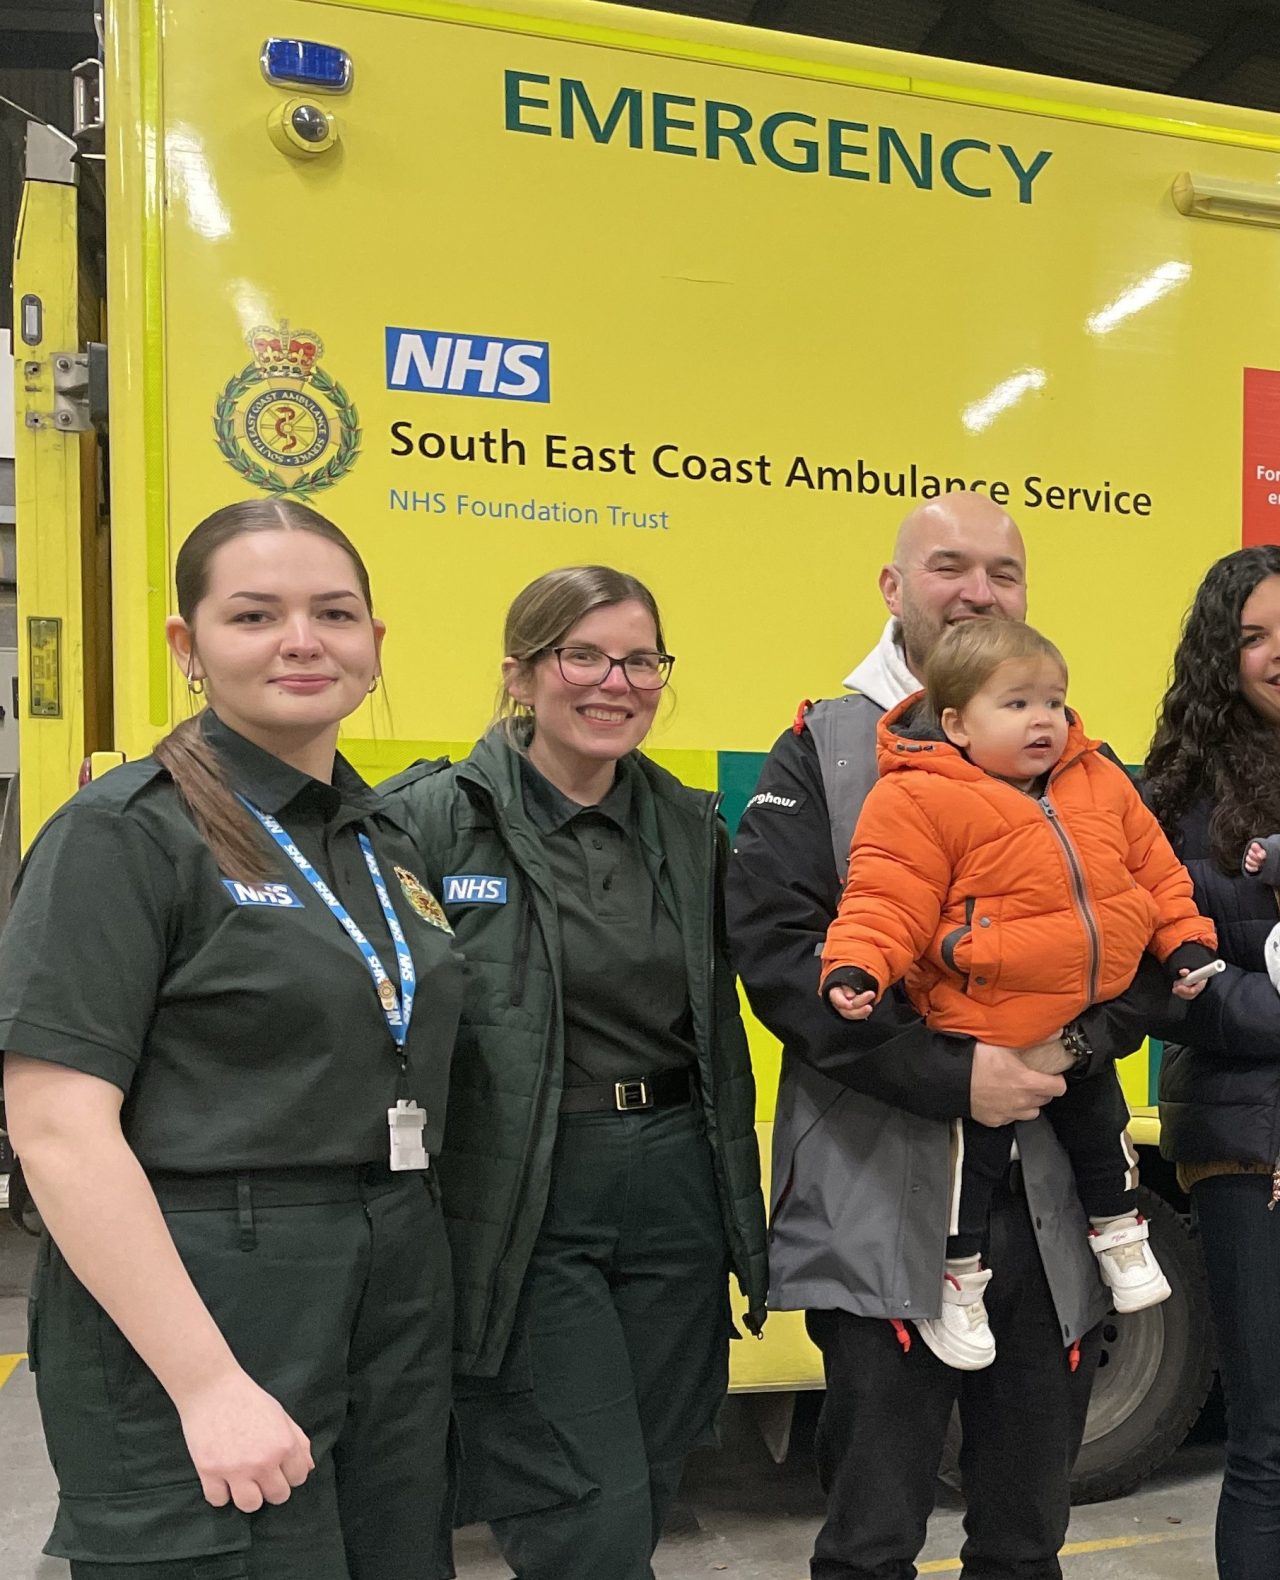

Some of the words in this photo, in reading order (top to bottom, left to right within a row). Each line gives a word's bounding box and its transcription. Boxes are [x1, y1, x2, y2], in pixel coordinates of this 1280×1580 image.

[504, 69, 1053, 204] EMERGENCY
[391, 333, 544, 397] NHS
[390, 421, 526, 466] South
[545, 434, 637, 475] East
[652, 444, 772, 486] Coast
[1024, 476, 1152, 516] Service
[390, 489, 446, 514] NHS
[457, 495, 598, 525] Foundation
[606, 505, 669, 530] Trust
[747, 792, 797, 807] ghaus
[449, 879, 502, 900] NHS
